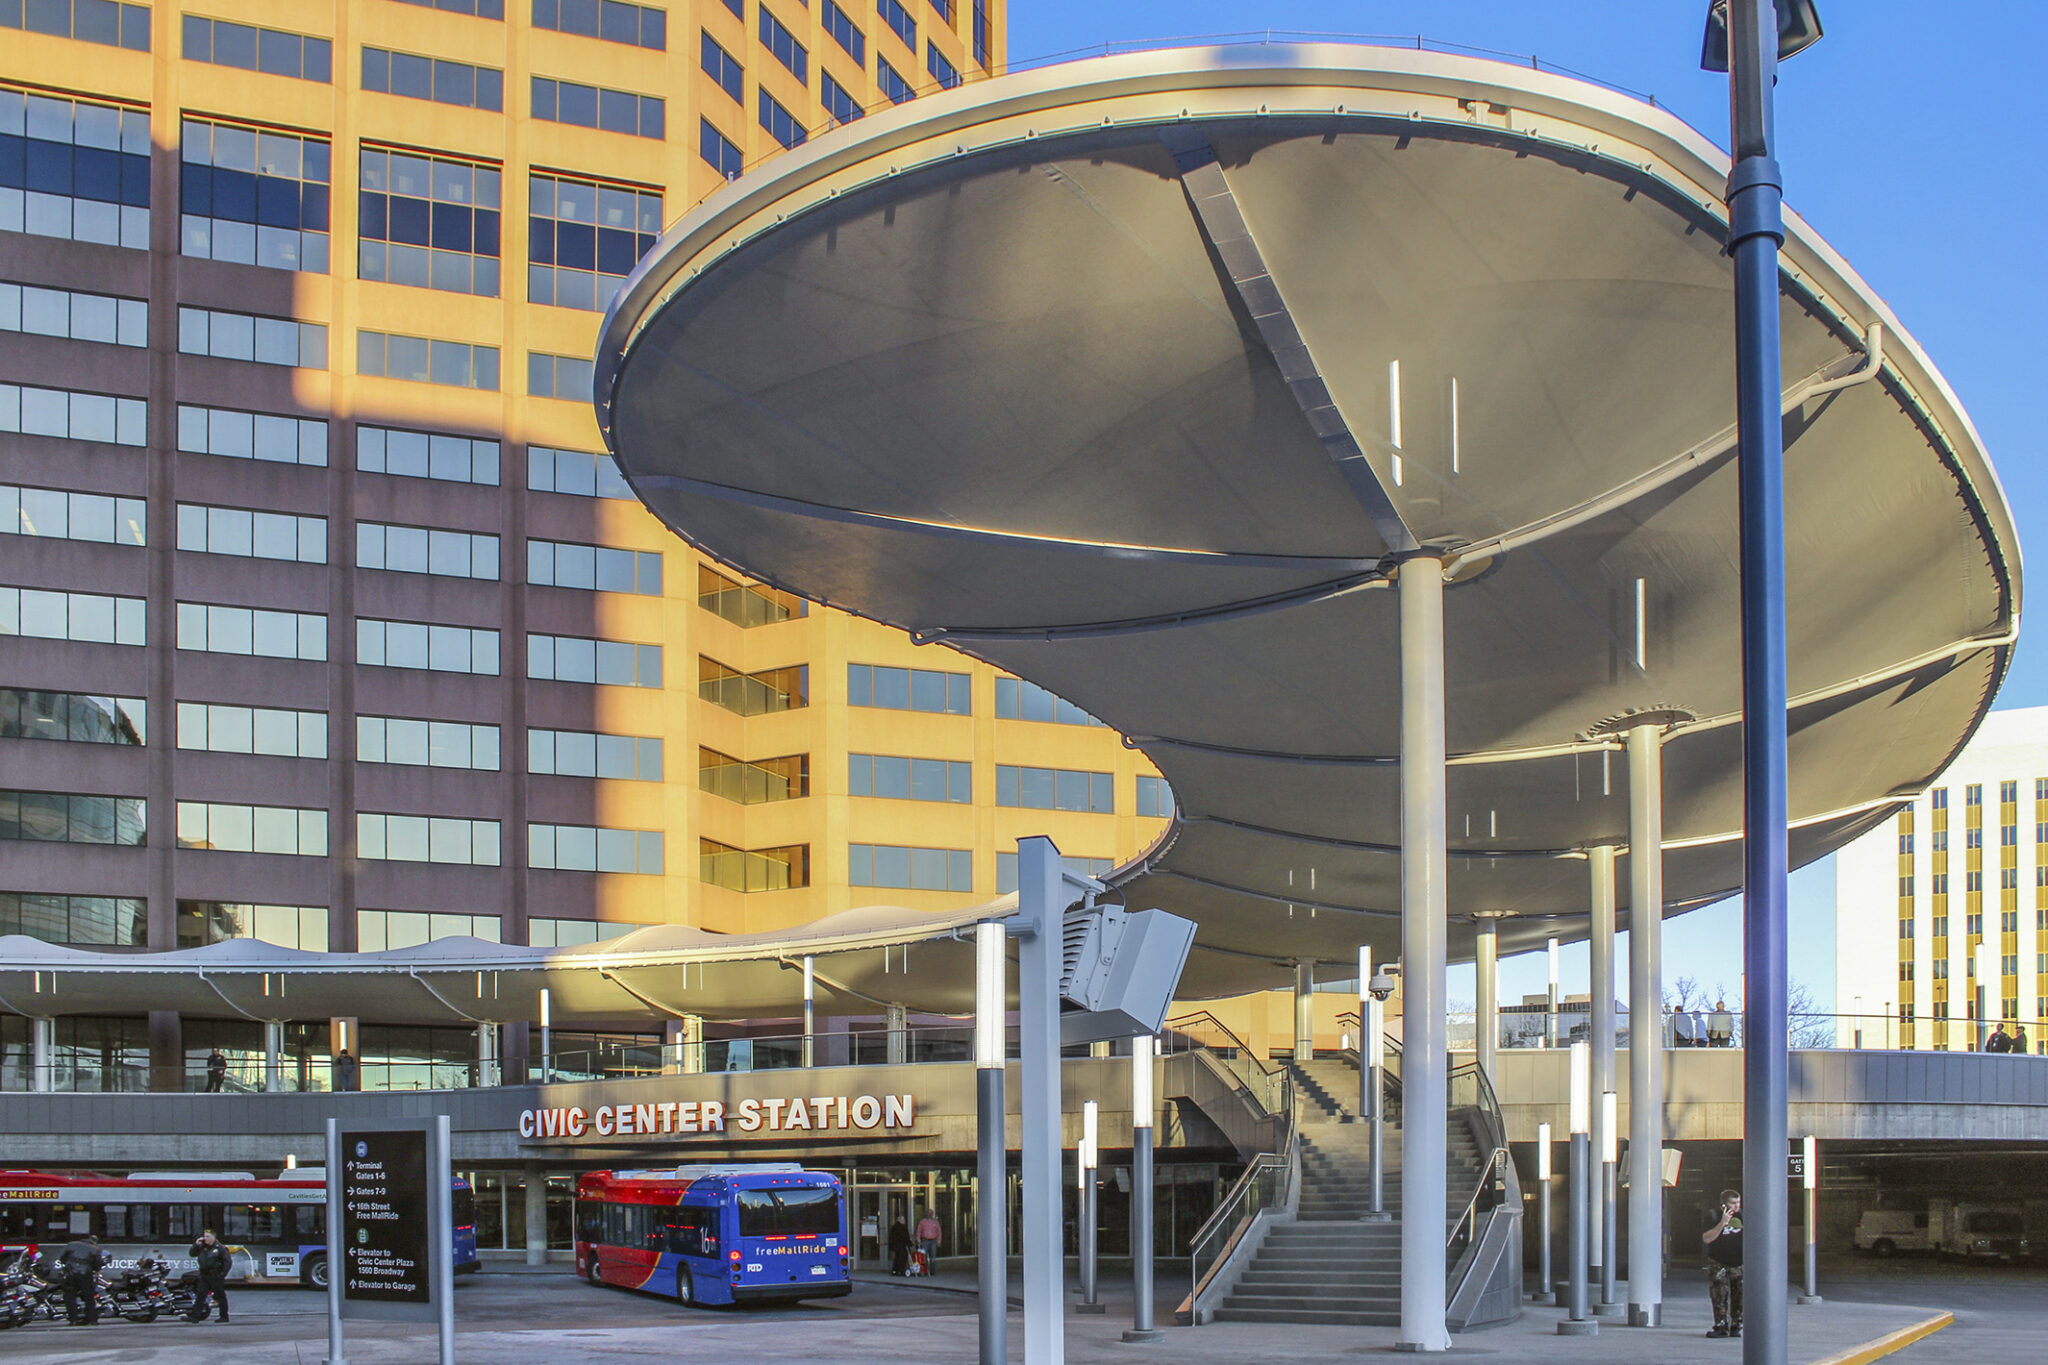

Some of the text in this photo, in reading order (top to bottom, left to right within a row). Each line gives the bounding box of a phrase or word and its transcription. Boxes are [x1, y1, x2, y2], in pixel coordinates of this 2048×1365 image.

[519, 1094, 914, 1138] CIVIC CENTER STATION
[356, 1161, 382, 1170] Terminal
[1794, 1164, 1802, 1173] 5
[356, 1171, 386, 1180] Gates 1-6
[0, 1190, 58, 1198] eMallRide
[356, 1187, 386, 1195] Gates 7-9
[357, 1202, 390, 1210] 16th Street
[371, 1211, 399, 1220] MallRide
[357, 1248, 391, 1257] Elevator to
[756, 1244, 826, 1256] freeMallRide
[357, 1257, 415, 1267] Civic Center Plaza
[373, 1267, 405, 1277] Broadway
[747, 1263, 763, 1273] RTD
[358, 1280, 416, 1291] Elevator to Garage
